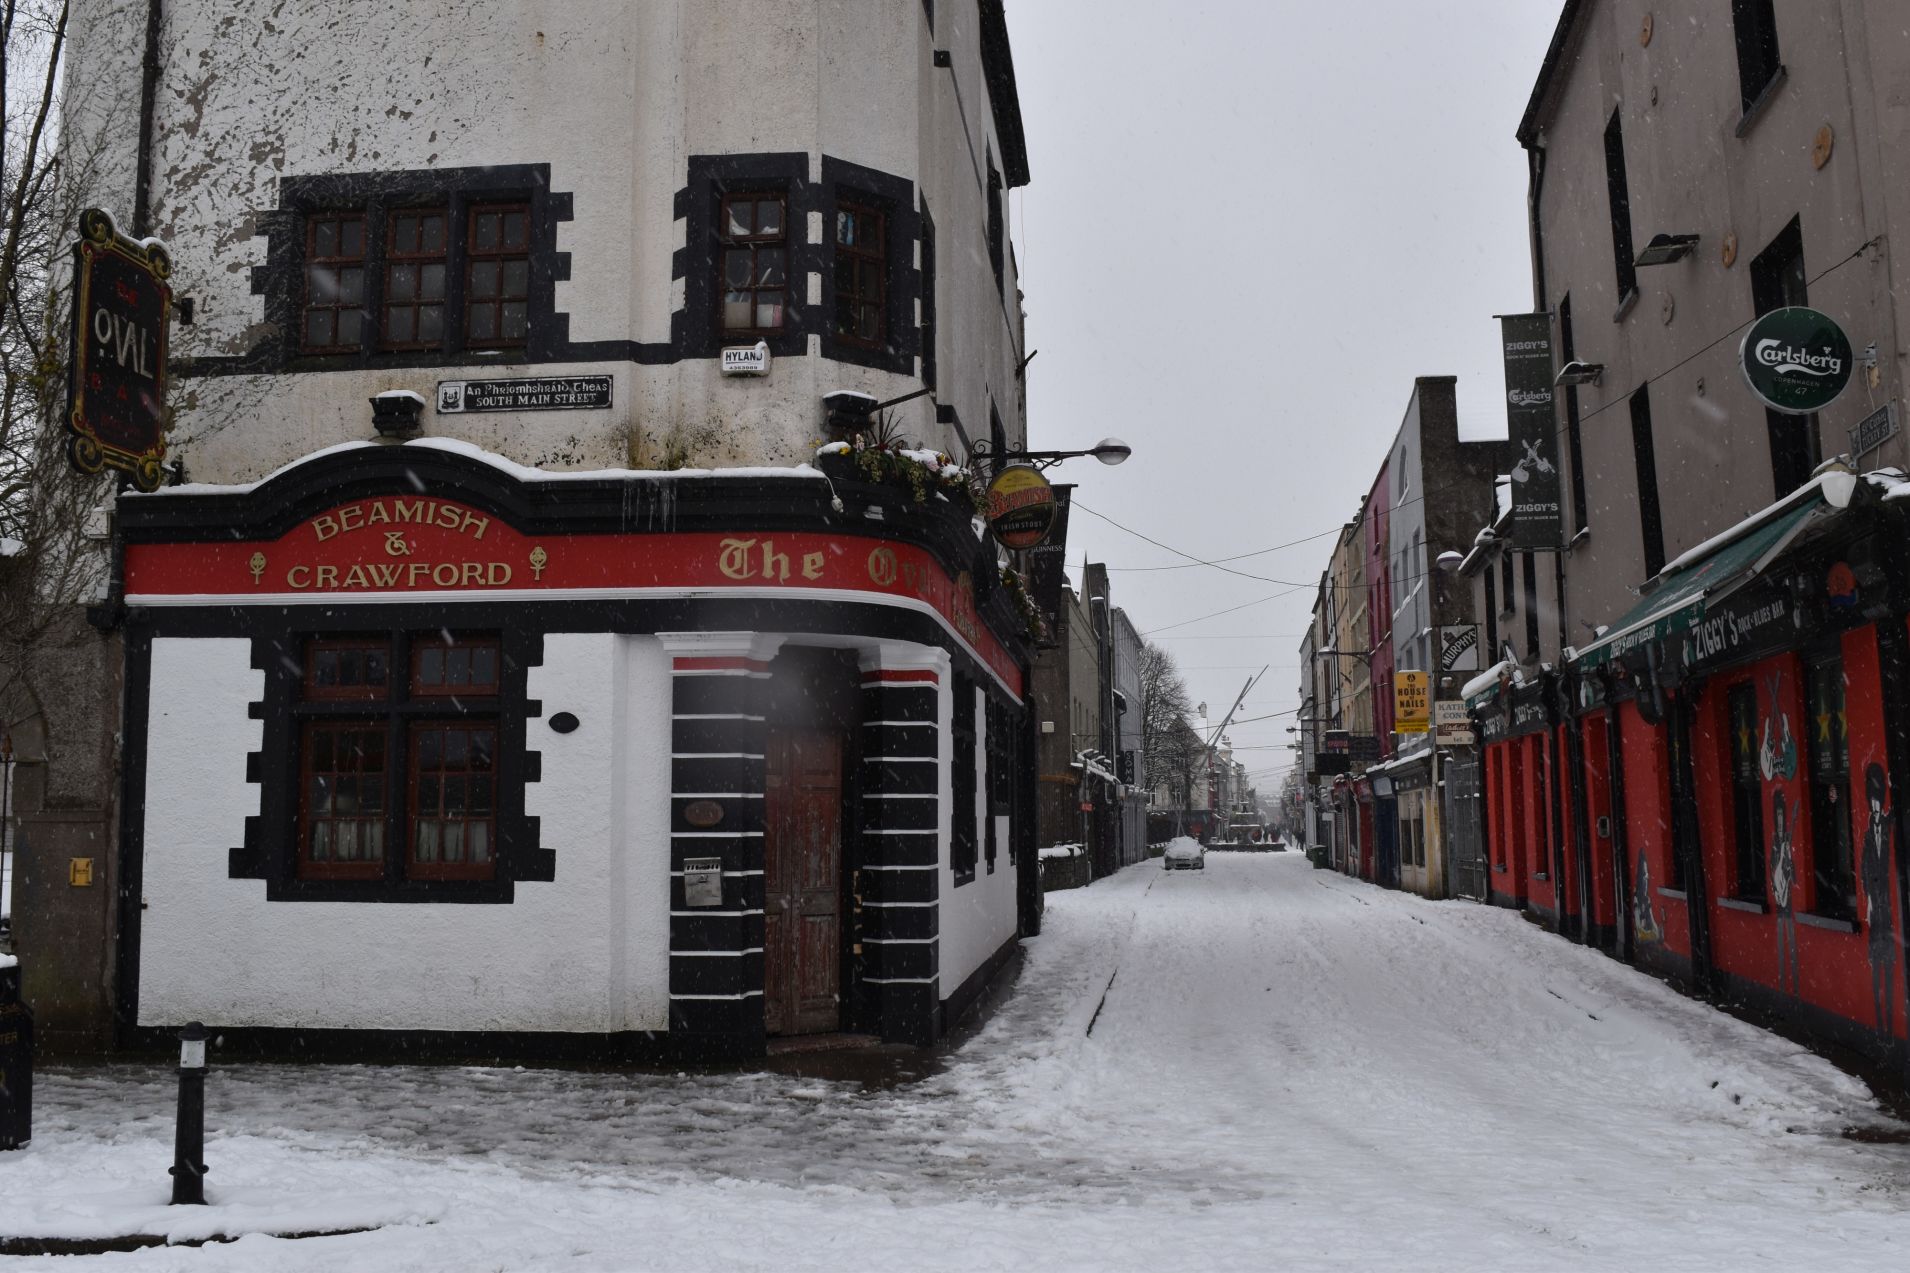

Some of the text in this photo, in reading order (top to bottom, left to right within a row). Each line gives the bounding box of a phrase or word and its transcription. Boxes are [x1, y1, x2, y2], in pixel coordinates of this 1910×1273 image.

[93, 307, 154, 380] OVAL
[1505, 340, 1549, 351] ZIGGY'S
[1755, 338, 1842, 375] Carlsberg
[466, 385, 481, 396] An
[571, 381, 608, 394] Theas
[1775, 377, 1821, 388] COPENHAGEN
[476, 393, 597, 407] SOUTH MAIN STREET
[1508, 389, 1552, 403] Carlsberg
[1515, 502, 1559, 512] ZIGGY'S
[311, 500, 490, 542] BEAMISH
[383, 531, 411, 556] &
[718, 537, 825, 585] The
[286, 561, 512, 588] CRAWFORD
[1691, 608, 1739, 661] ZIGGY'S
[1771, 599, 1785, 619] BAR
[1397, 688, 1426, 696] HOUSE
[1399, 700, 1425, 708] NAILS
